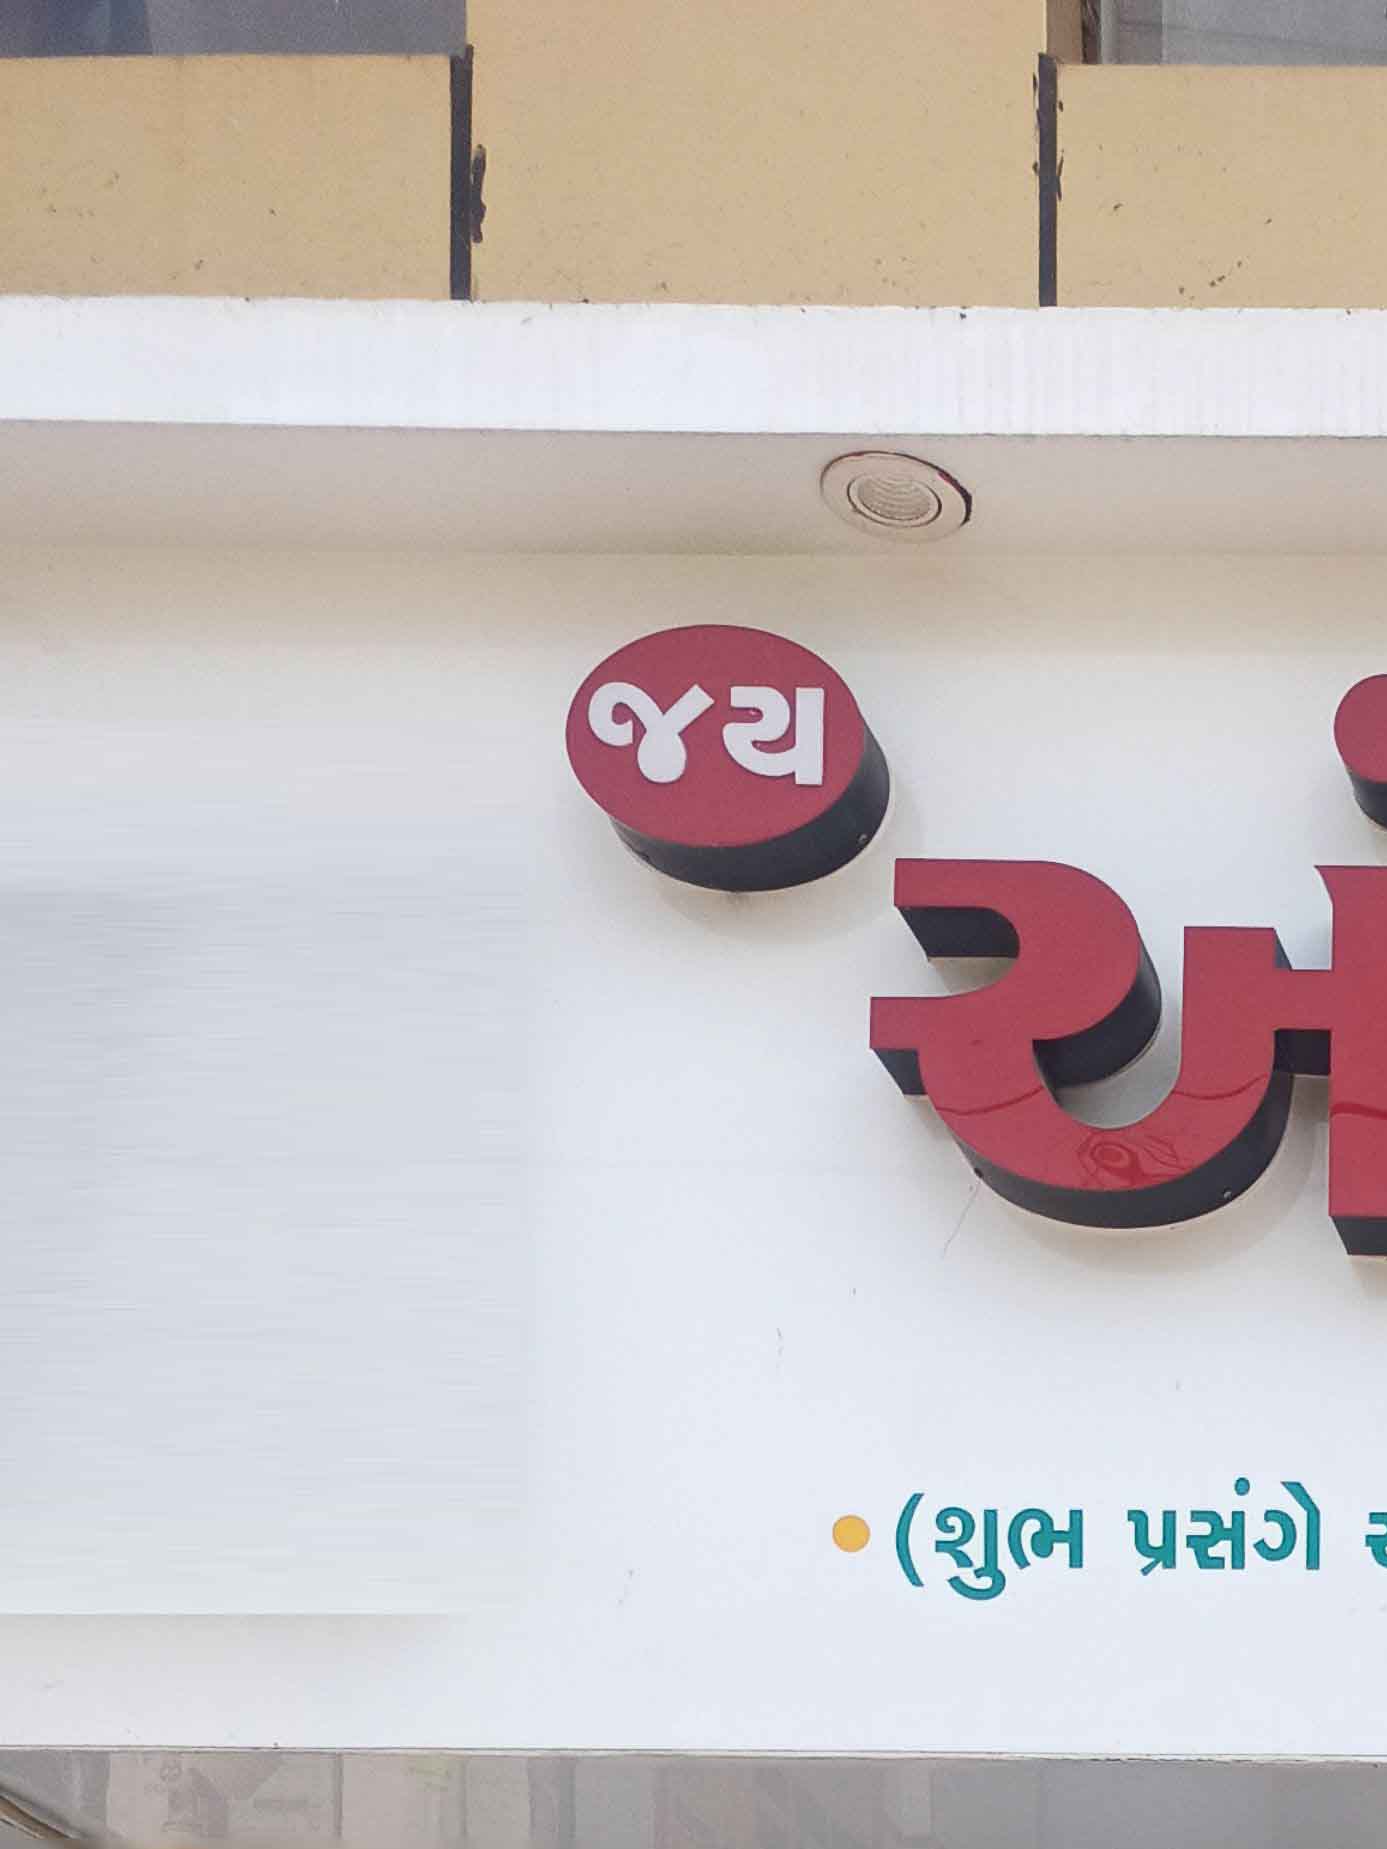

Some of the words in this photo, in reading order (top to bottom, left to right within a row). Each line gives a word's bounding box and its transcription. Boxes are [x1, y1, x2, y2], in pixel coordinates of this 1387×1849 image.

[587, 682, 826, 786] જય
[895, 1492, 1084, 1600] (શુભ
[1127, 1476, 1321, 1577] પ્રસંગે
